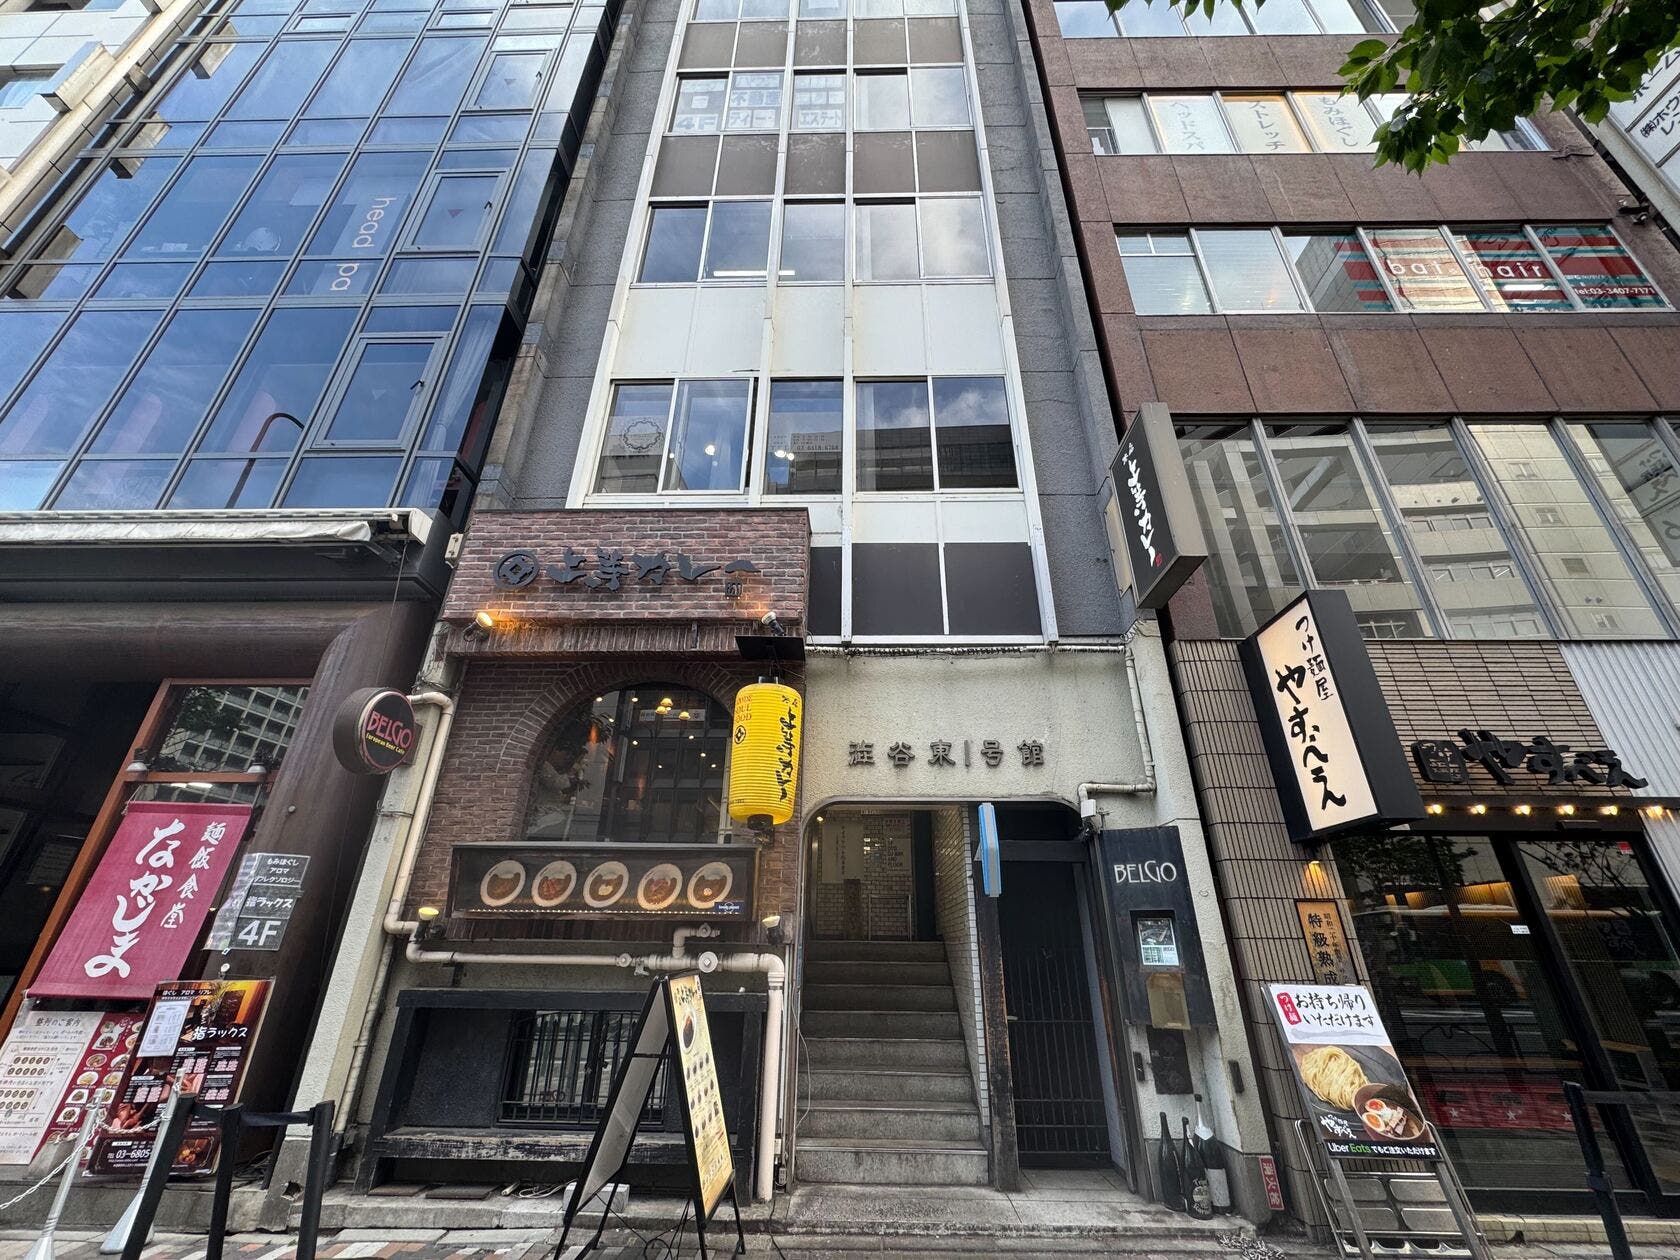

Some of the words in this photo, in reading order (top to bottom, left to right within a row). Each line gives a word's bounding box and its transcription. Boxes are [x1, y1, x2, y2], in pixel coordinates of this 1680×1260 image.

[675, 115, 717, 130] 4F
[799, 110, 841, 127] エステート
[1249, 100, 1286, 151] ストレッチ
[351, 196, 397, 248] head
[1471, 261, 1543, 278] hair
[1295, 615, 1335, 701] つけ麺屋
[366, 710, 412, 749] BELGO
[1275, 663, 1348, 811] やすべえ
[1457, 727, 1649, 790] やすべえ
[160, 820, 227, 929] 麺飯食堂
[267, 858, 300, 867] もみほぐし
[269, 867, 290, 875] アロマ
[1113, 860, 1178, 884] BELGO
[238, 919, 282, 946] 4F
[1307, 912, 1340, 985] 特級熟成
[1294, 992, 1367, 1011] お持ち帰り
[1302, 1012, 1375, 1029] いただけます
[192, 1025, 248, 1041] 指ラックス
[1327, 1142, 1350, 1153] Uber
[1349, 1142, 1372, 1154] Eats
